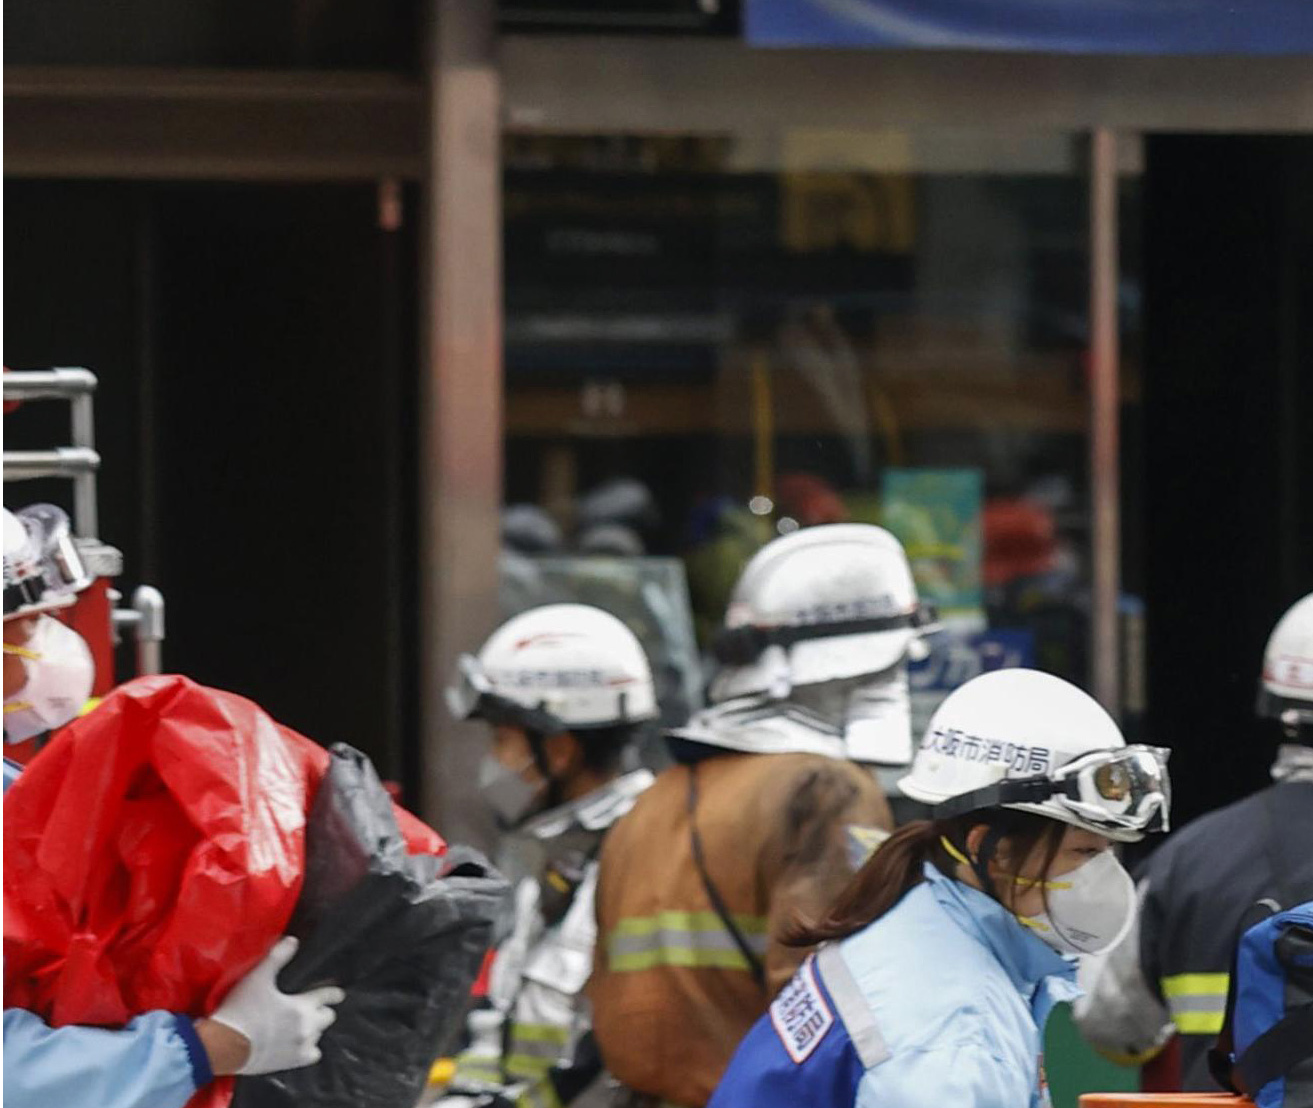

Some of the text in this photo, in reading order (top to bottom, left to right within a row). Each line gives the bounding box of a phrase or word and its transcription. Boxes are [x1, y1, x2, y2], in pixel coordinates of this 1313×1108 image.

[919, 727, 1050, 774] 大阪市消防局
